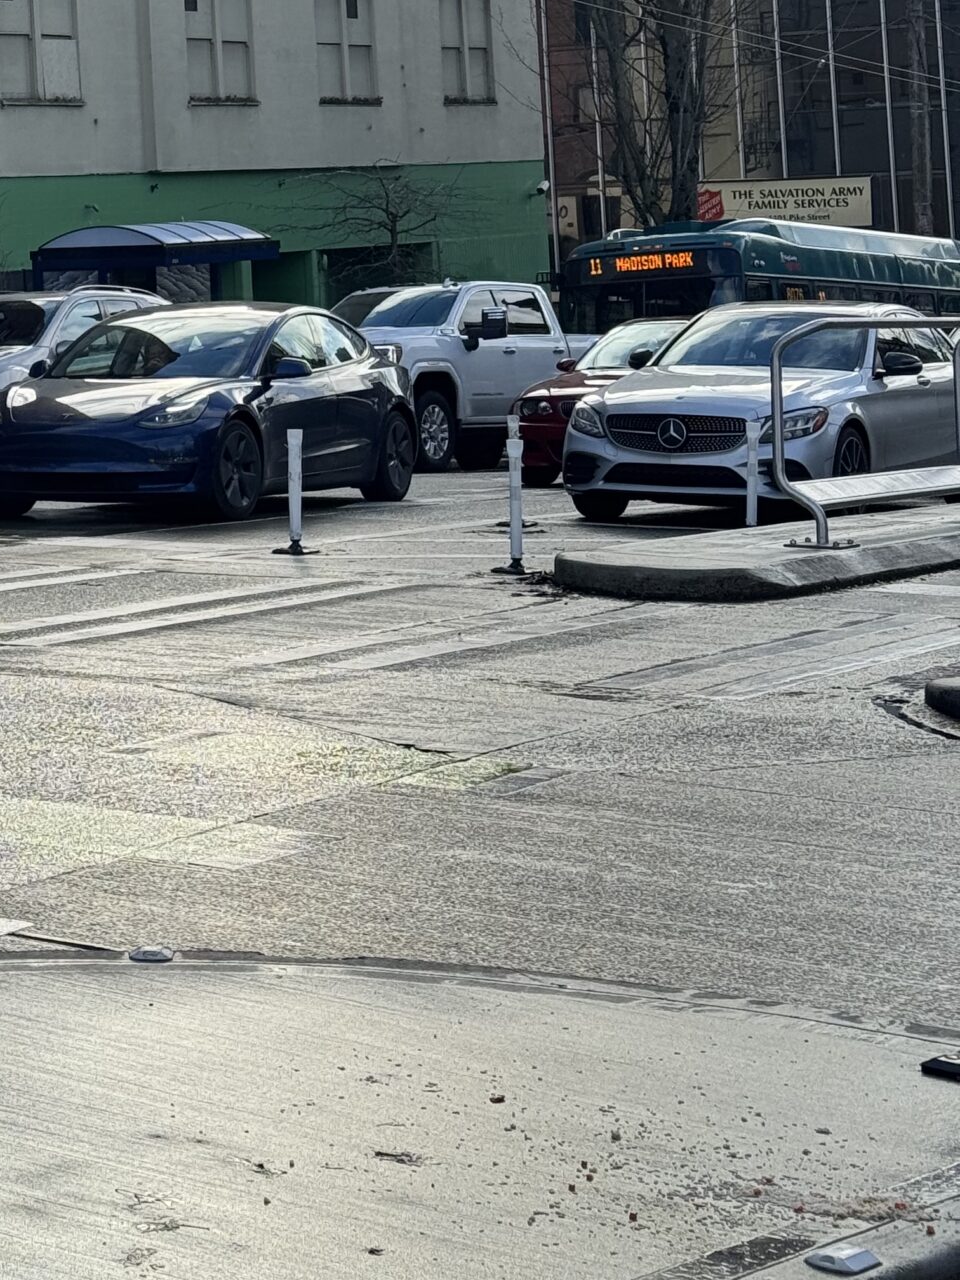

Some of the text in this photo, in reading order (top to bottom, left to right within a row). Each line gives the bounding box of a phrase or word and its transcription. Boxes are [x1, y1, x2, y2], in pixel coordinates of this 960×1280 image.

[730, 186, 865, 200] THE SALVATION ARMY
[748, 197, 849, 210] FAMILY SERVICES
[807, 213, 830, 221] Street
[590, 251, 694, 275] 11 MADISON PARK
